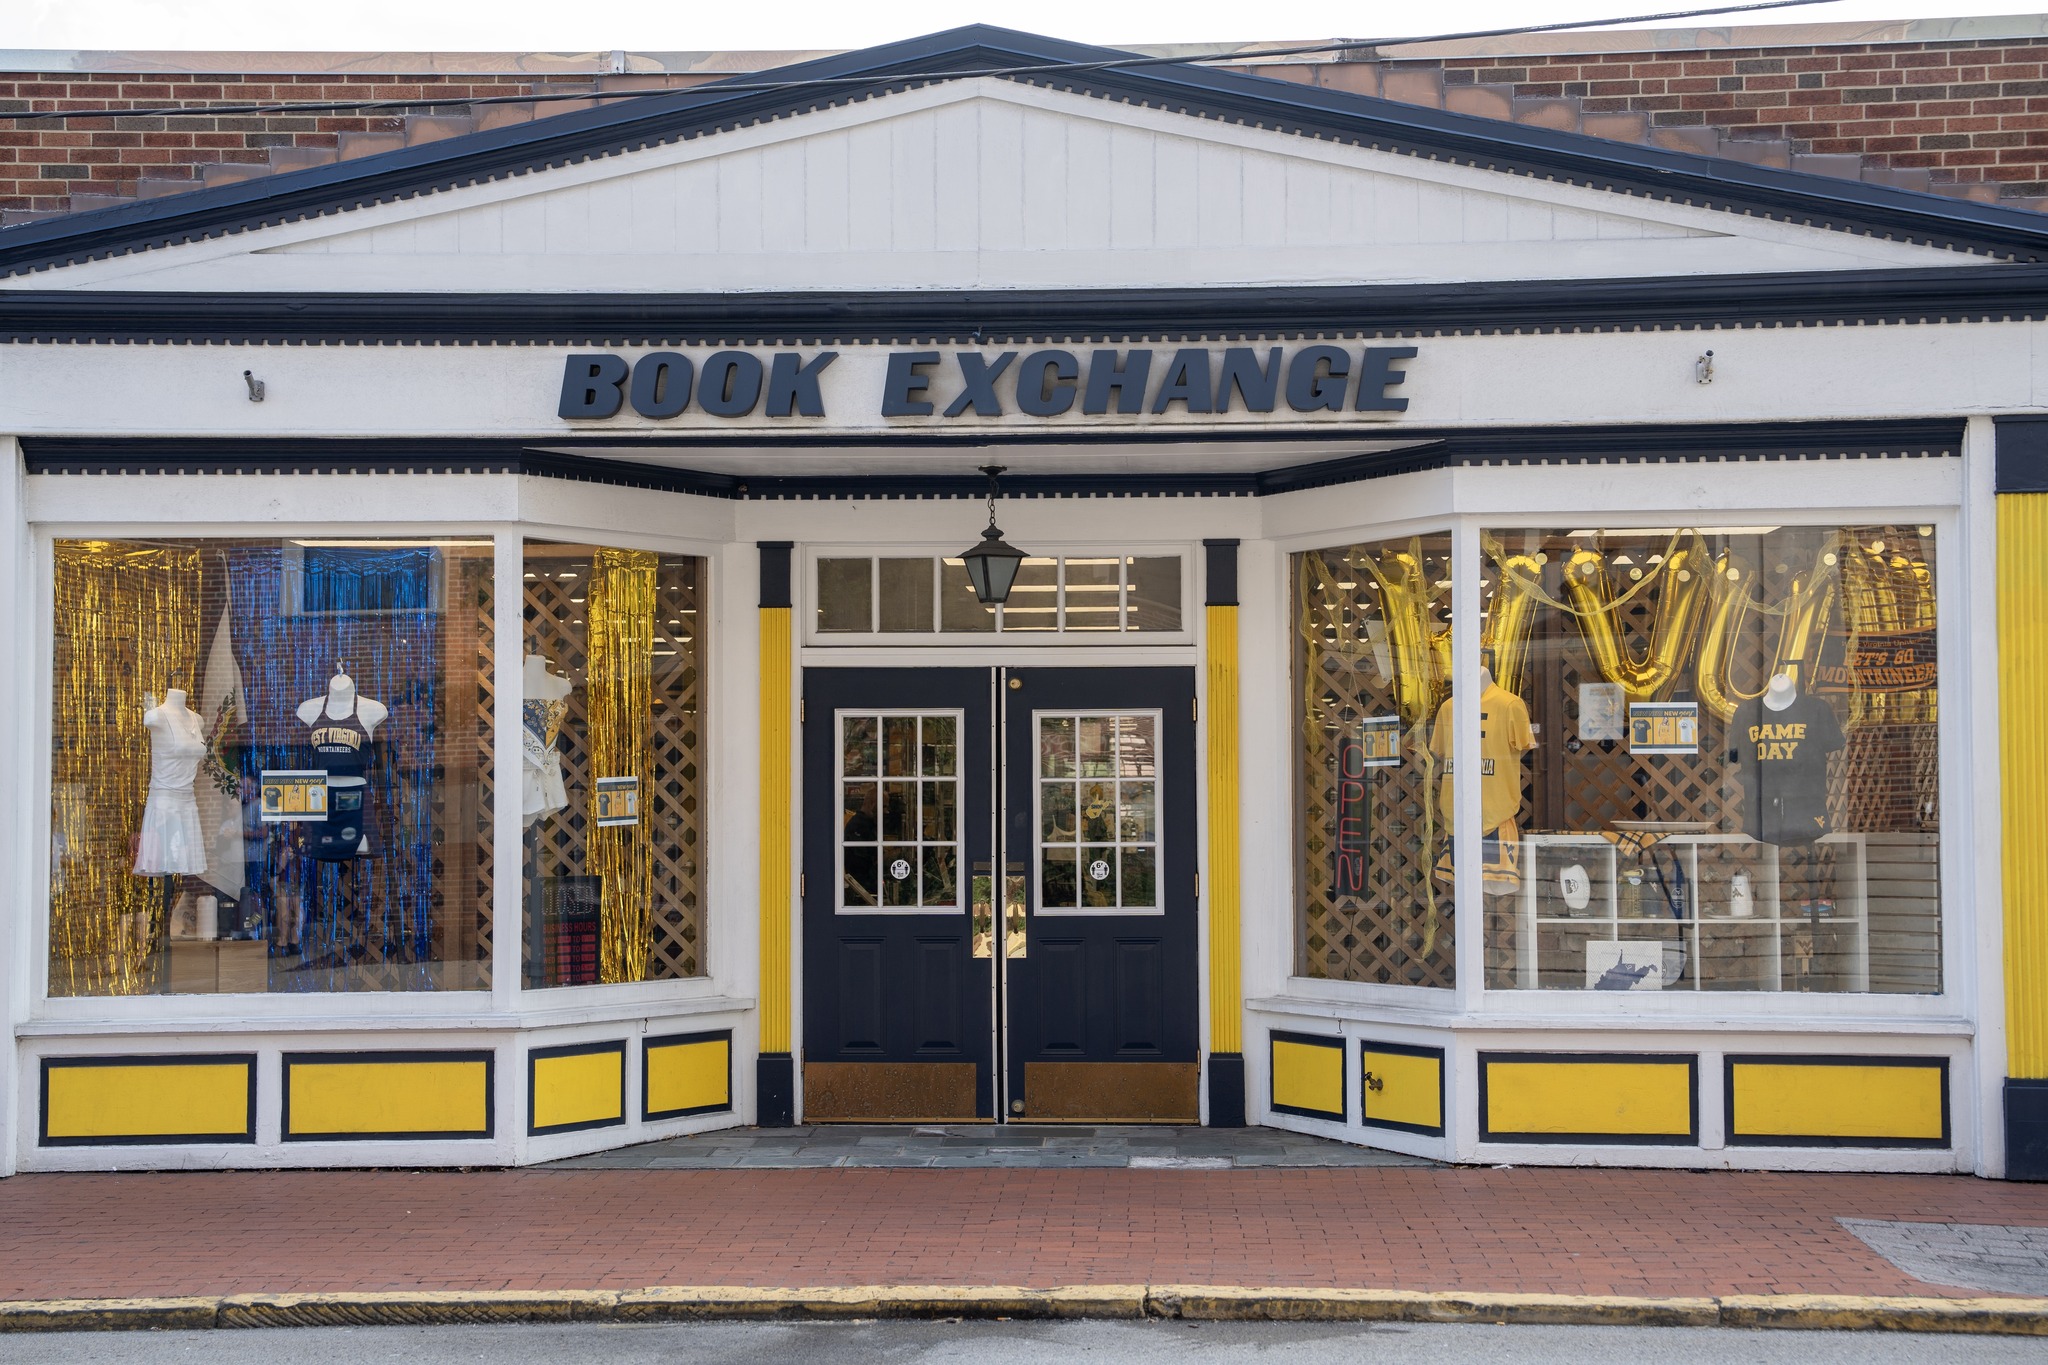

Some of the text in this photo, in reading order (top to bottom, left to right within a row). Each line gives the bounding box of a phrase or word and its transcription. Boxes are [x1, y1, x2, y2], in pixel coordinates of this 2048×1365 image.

[558, 344, 1419, 419] BOOK EXCHANGE
[1893, 648, 1915, 664] GO
[1748, 723, 1807, 743] GAME
[1757, 742, 1799, 760] DAY
[1338, 744, 1366, 891] OPEN
[543, 921, 597, 934] BUSINESS HOURS
